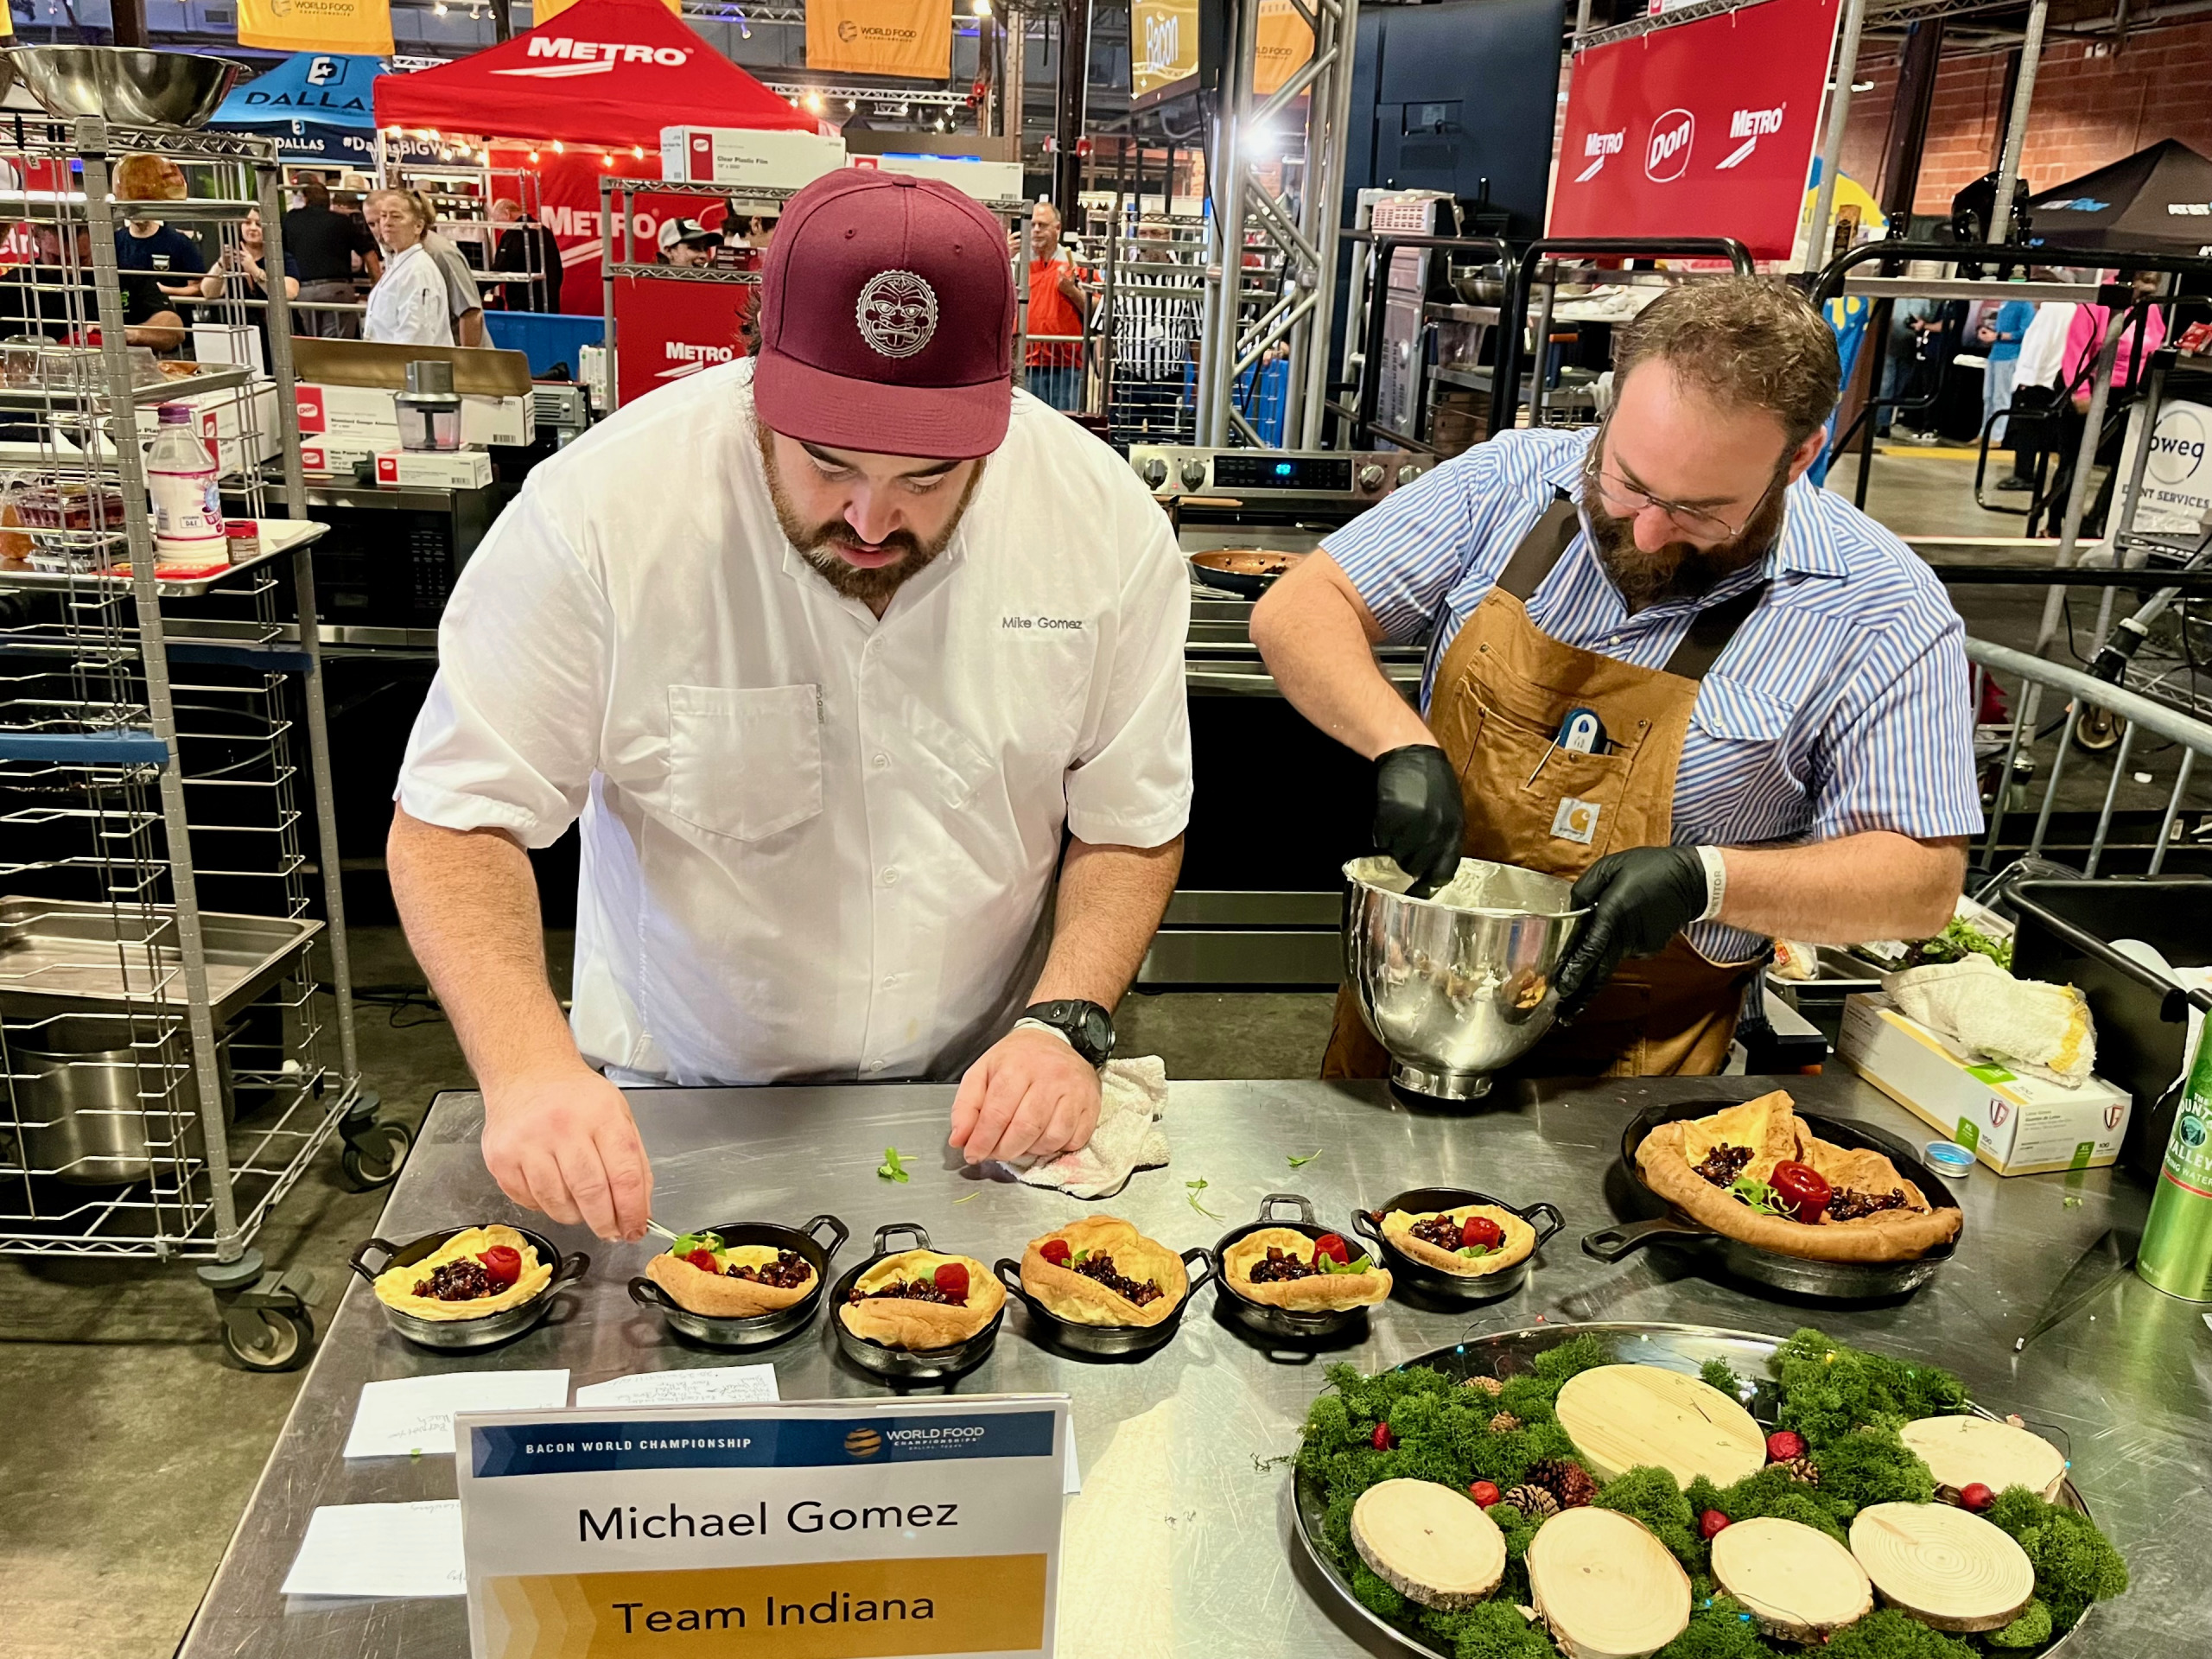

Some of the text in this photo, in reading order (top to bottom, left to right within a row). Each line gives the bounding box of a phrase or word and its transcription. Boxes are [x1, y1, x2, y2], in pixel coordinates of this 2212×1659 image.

[295, 1, 354, 11] WORLD FOOD
[861, 26, 917, 38] WORLD FOOD
[527, 37, 687, 66] METRO
[1146, 16, 1179, 73] Bacon
[245, 92, 374, 111] DALLA
[1730, 107, 1783, 138] METRO
[277, 137, 325, 151] DALLAS
[1585, 132, 1624, 156] METRO
[1649, 120, 1690, 170] Don
[541, 206, 657, 239] METRO
[666, 341, 733, 362] METRO
[2157, 490, 2210, 509] SERVICES
[1002, 616, 1083, 630] Mike Gomez
[1963, 1122, 1974, 1133] XL
[887, 1427, 984, 1440] WORLD FOOD
[893, 1438, 977, 1446] CHAMPIONSHIPS
[525, 1438, 752, 1454] BACON WORLD CHAMPIONSHIP
[579, 1500, 958, 1541] Michael Gomez
[612, 1591, 935, 1633] Team Indiana
